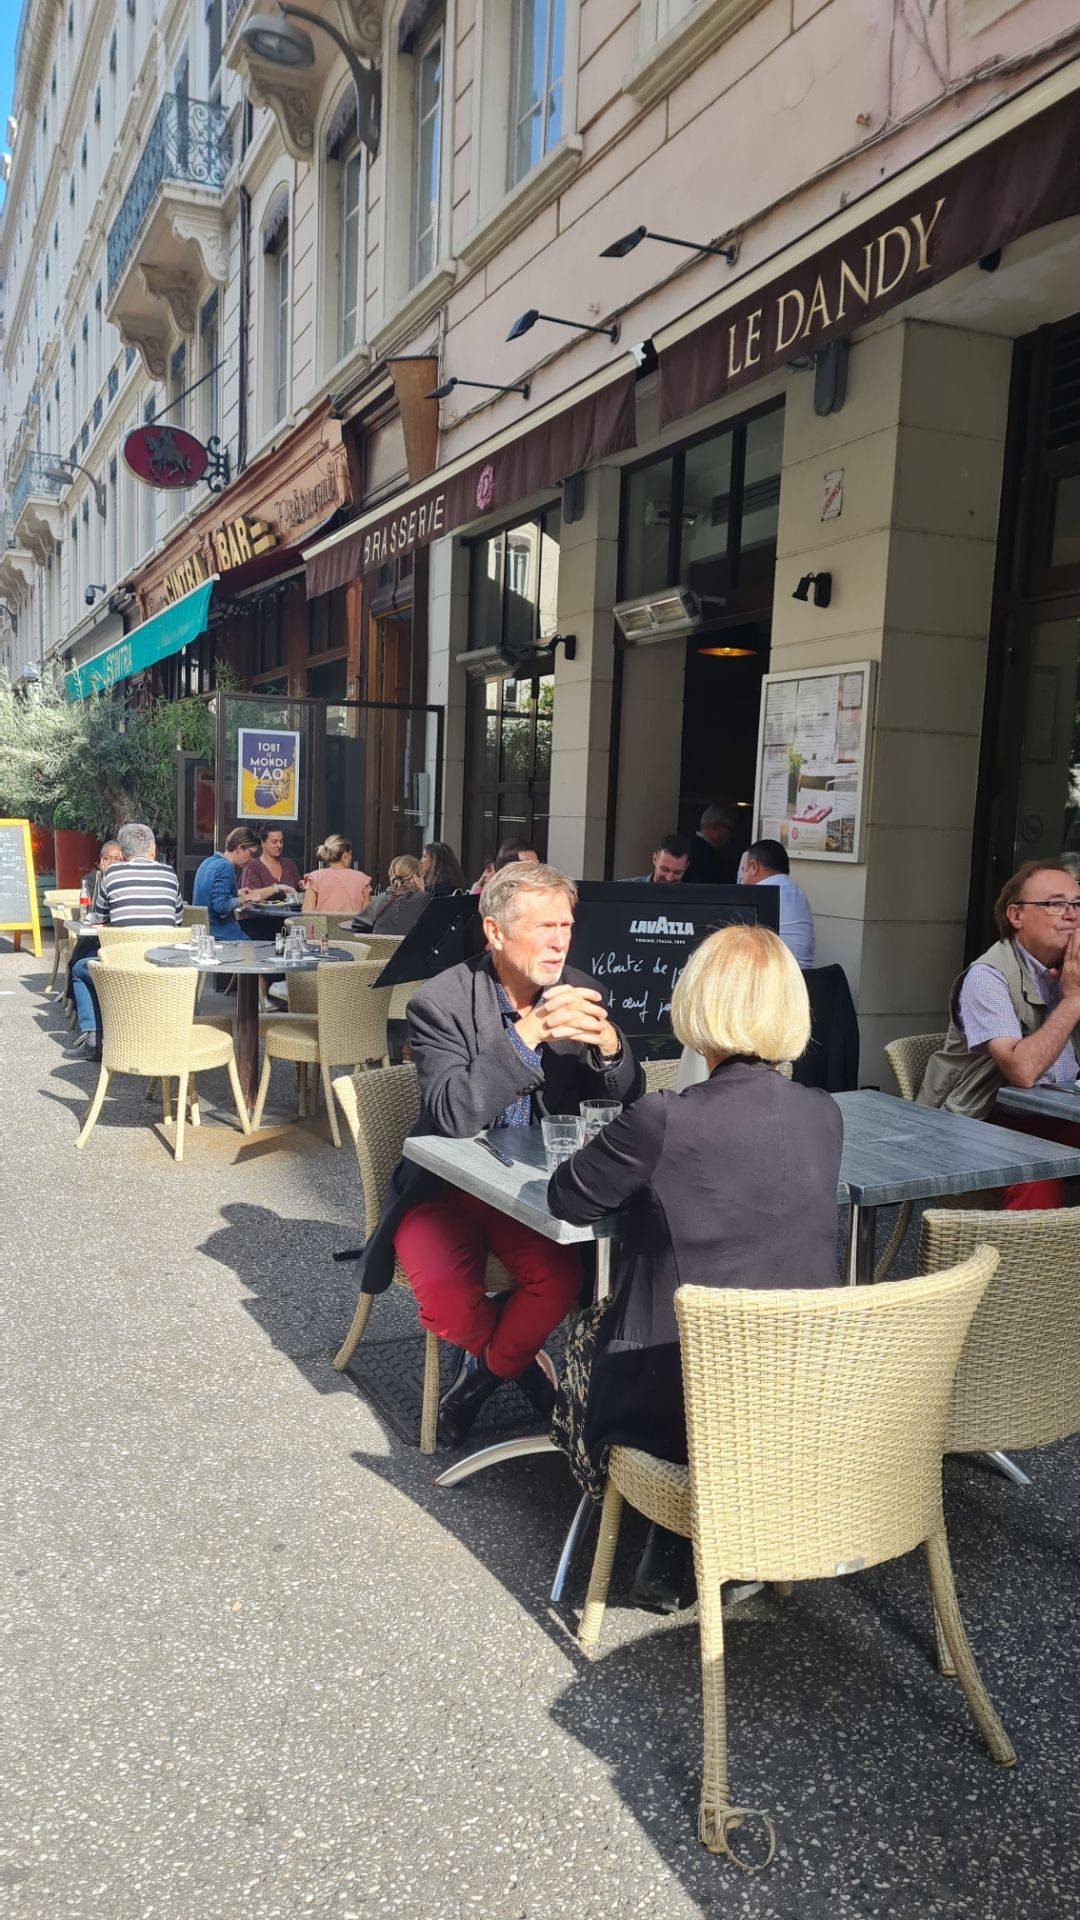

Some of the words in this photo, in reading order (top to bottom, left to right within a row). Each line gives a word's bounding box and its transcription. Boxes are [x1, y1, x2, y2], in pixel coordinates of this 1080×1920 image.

[727, 308, 763, 378] LE
[775, 196, 946, 353] DANDY
[363, 494, 445, 565] BRASSERIE
[216, 517, 252, 571] BAR
[258, 742, 280, 752] TOUT
[250, 757, 288, 767] MONDE
[629, 916, 694, 935] LAVAZZA
[592, 952, 643, 975] Velouté
[653, 957, 669, 974] de
